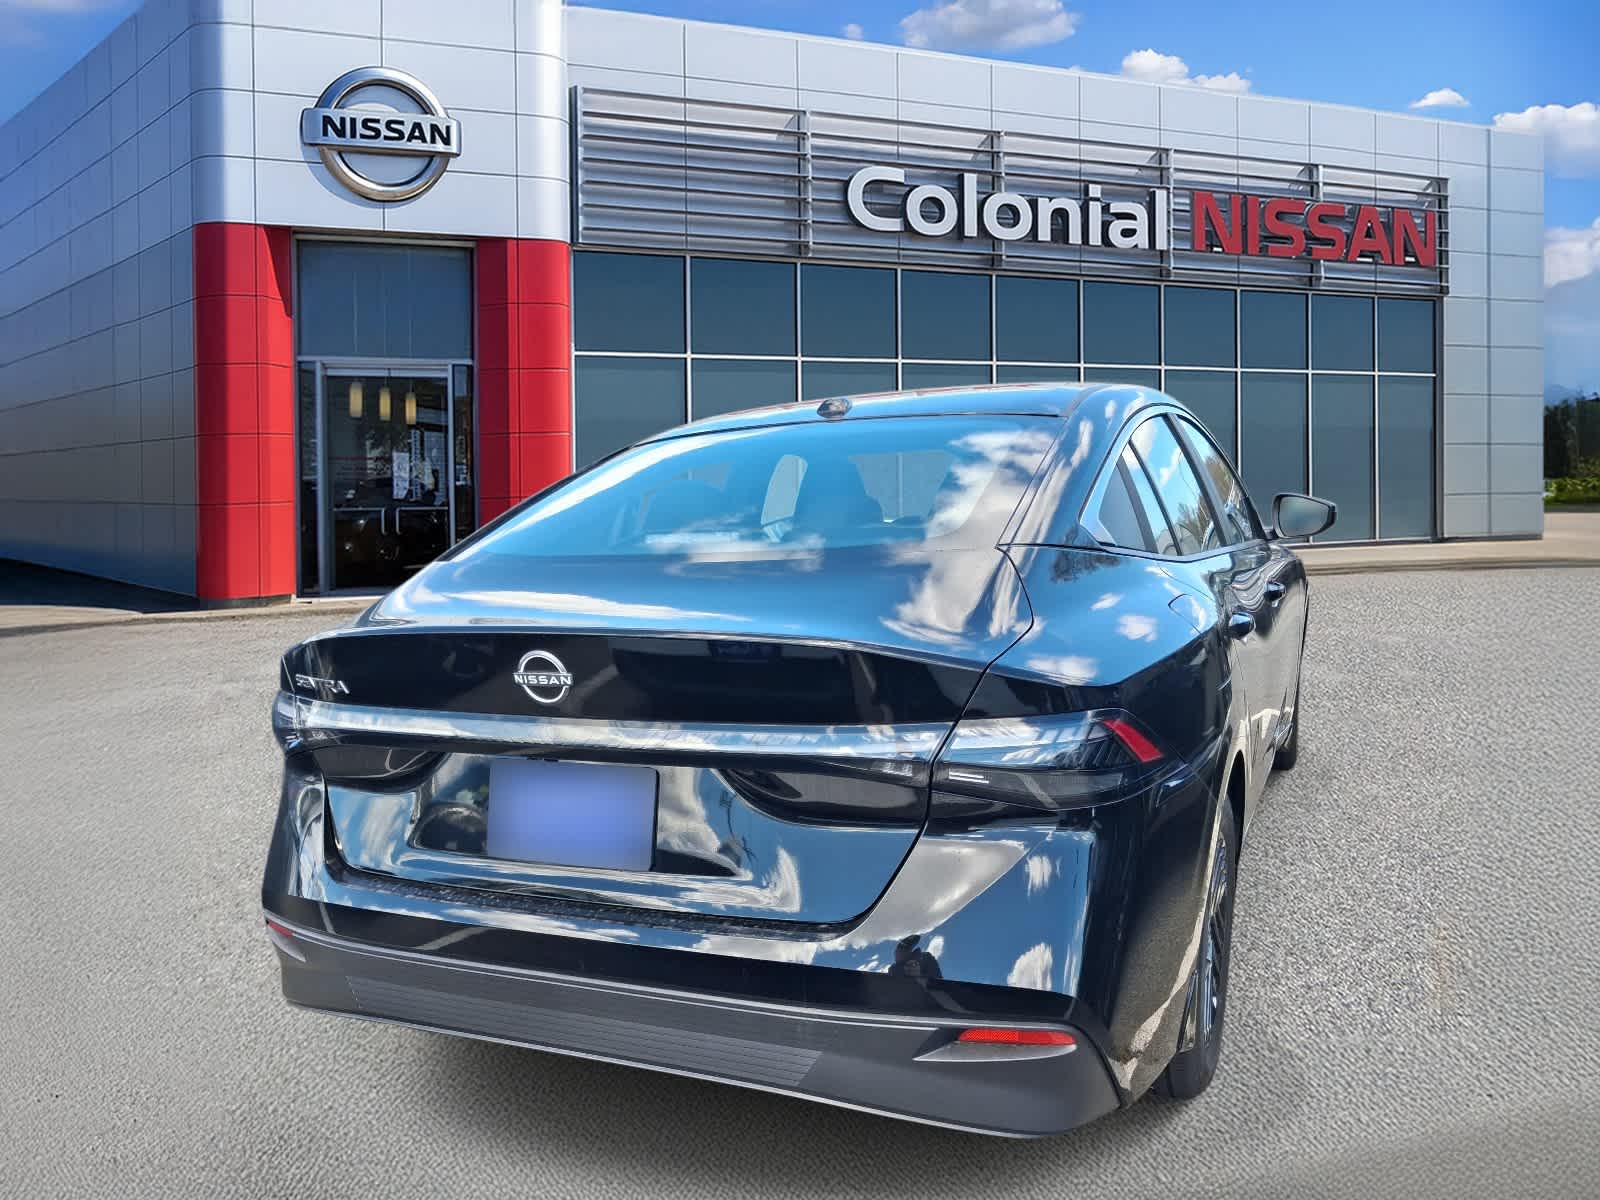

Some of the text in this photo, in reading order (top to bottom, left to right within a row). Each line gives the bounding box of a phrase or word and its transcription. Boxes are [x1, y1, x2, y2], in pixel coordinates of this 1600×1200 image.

[321, 115, 452, 146] NISSAN
[847, 165, 1437, 267] Colonial NISSAN
[513, 674, 573, 685] NISSAN
